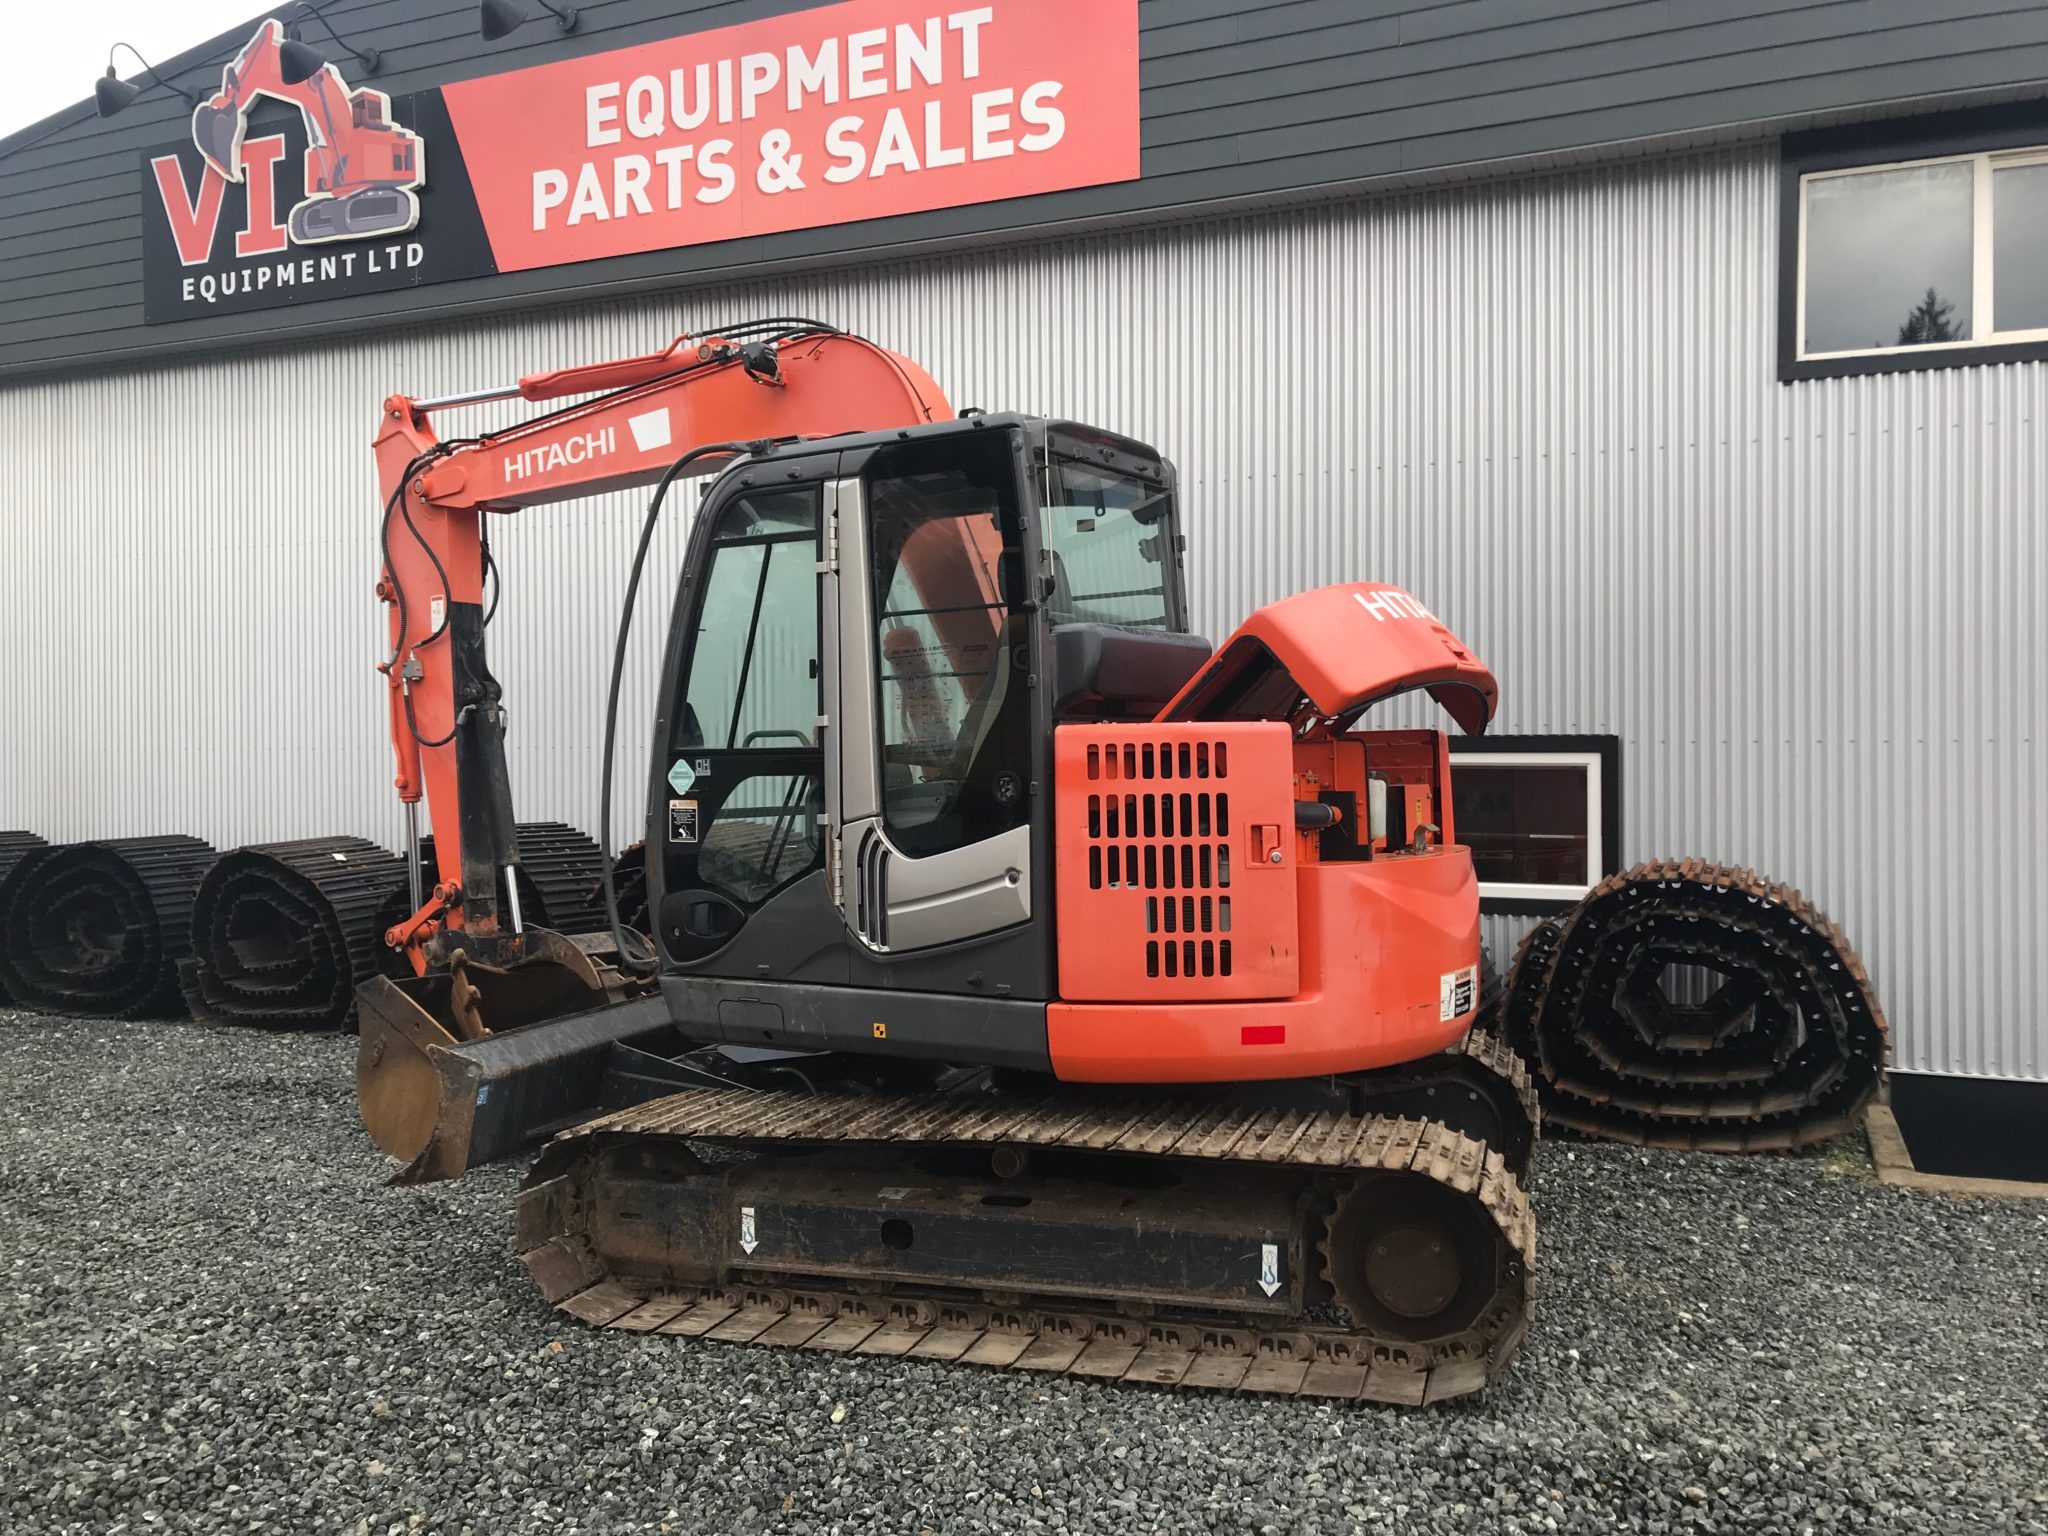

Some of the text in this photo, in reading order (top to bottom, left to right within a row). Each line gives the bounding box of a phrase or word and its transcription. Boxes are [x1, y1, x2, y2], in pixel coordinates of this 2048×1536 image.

[584, 6, 994, 148] EQUIPMENT
[150, 132, 289, 267] VI
[532, 80, 1066, 231] PARTS & SALES
[182, 242, 425, 303] EQUIPMENT LTD
[503, 426, 616, 483] HITACHI
